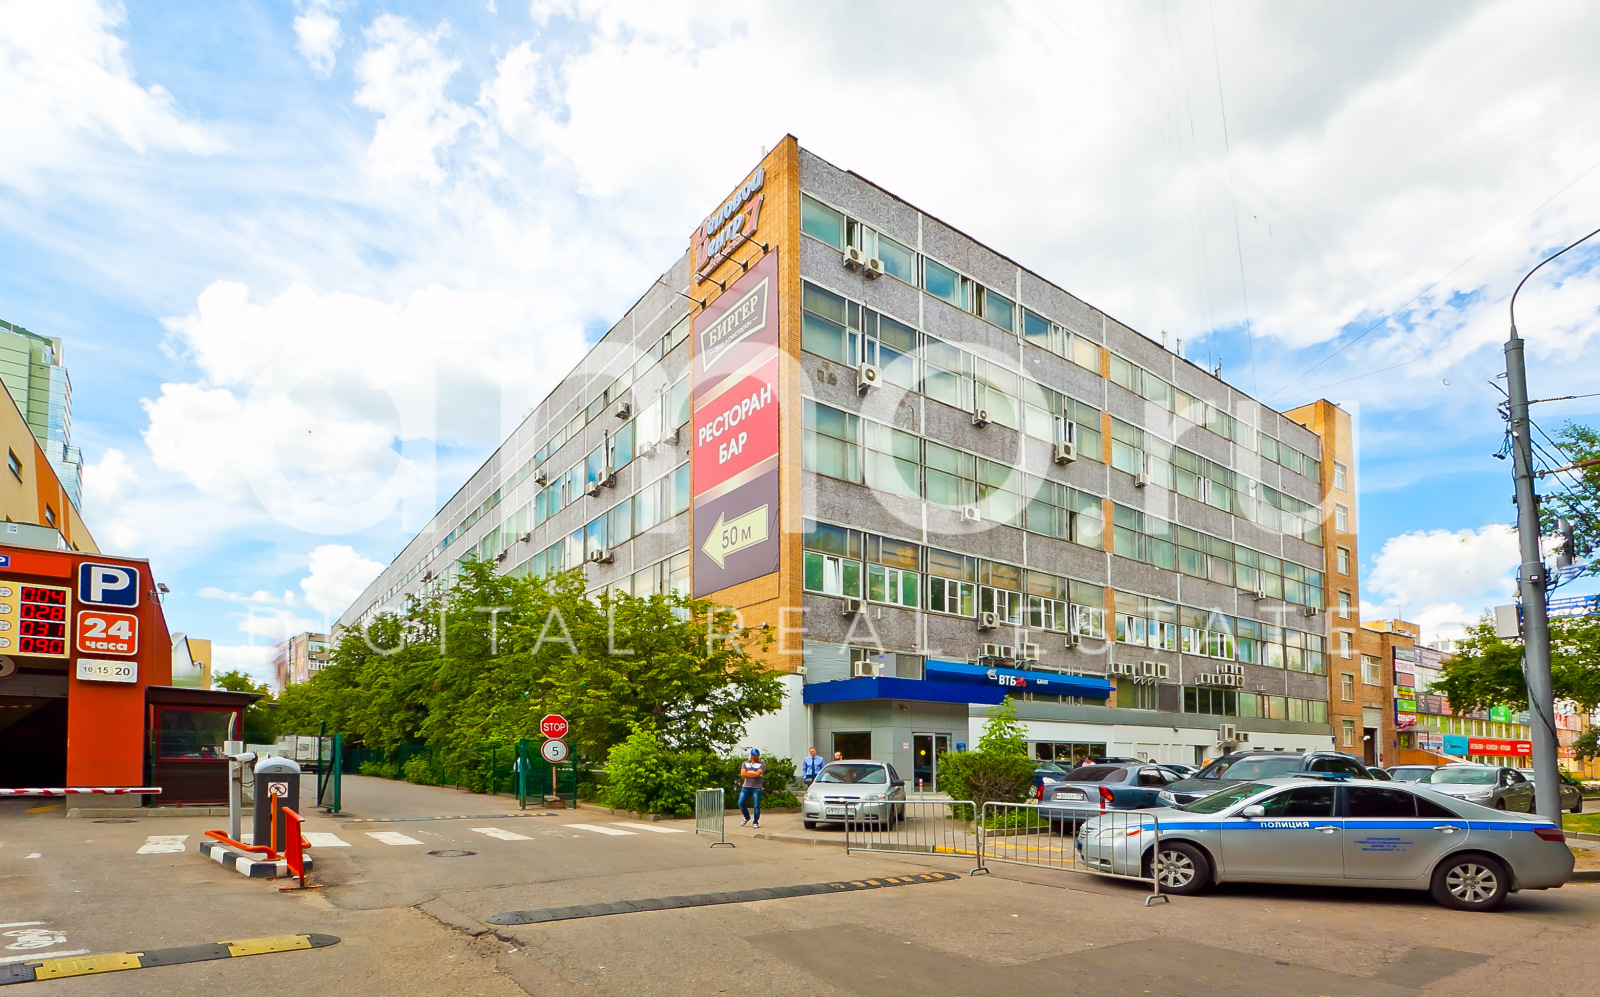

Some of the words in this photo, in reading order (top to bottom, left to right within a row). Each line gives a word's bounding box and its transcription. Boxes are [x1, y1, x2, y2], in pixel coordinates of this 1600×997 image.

[708, 294, 759, 348] БИРГЕР
[698, 382, 772, 448] РЕСТОРАН
[718, 431, 748, 465] БАР
[721, 525, 738, 550] 50
[90, 565, 130, 602] P
[22, 587, 64, 604] 004
[21, 604, 64, 621] 028
[20, 621, 63, 637] 031
[83, 616, 133, 640] 24
[20, 637, 63, 654] 090
[85, 640, 128, 651] часа
[97, 666, 109, 674] 15
[114, 667, 131, 676] 20
[543, 722, 566, 732] STOP
[552, 746, 559, 757] 5
[1260, 821, 1310, 829] ПОЛИЦИЯ
